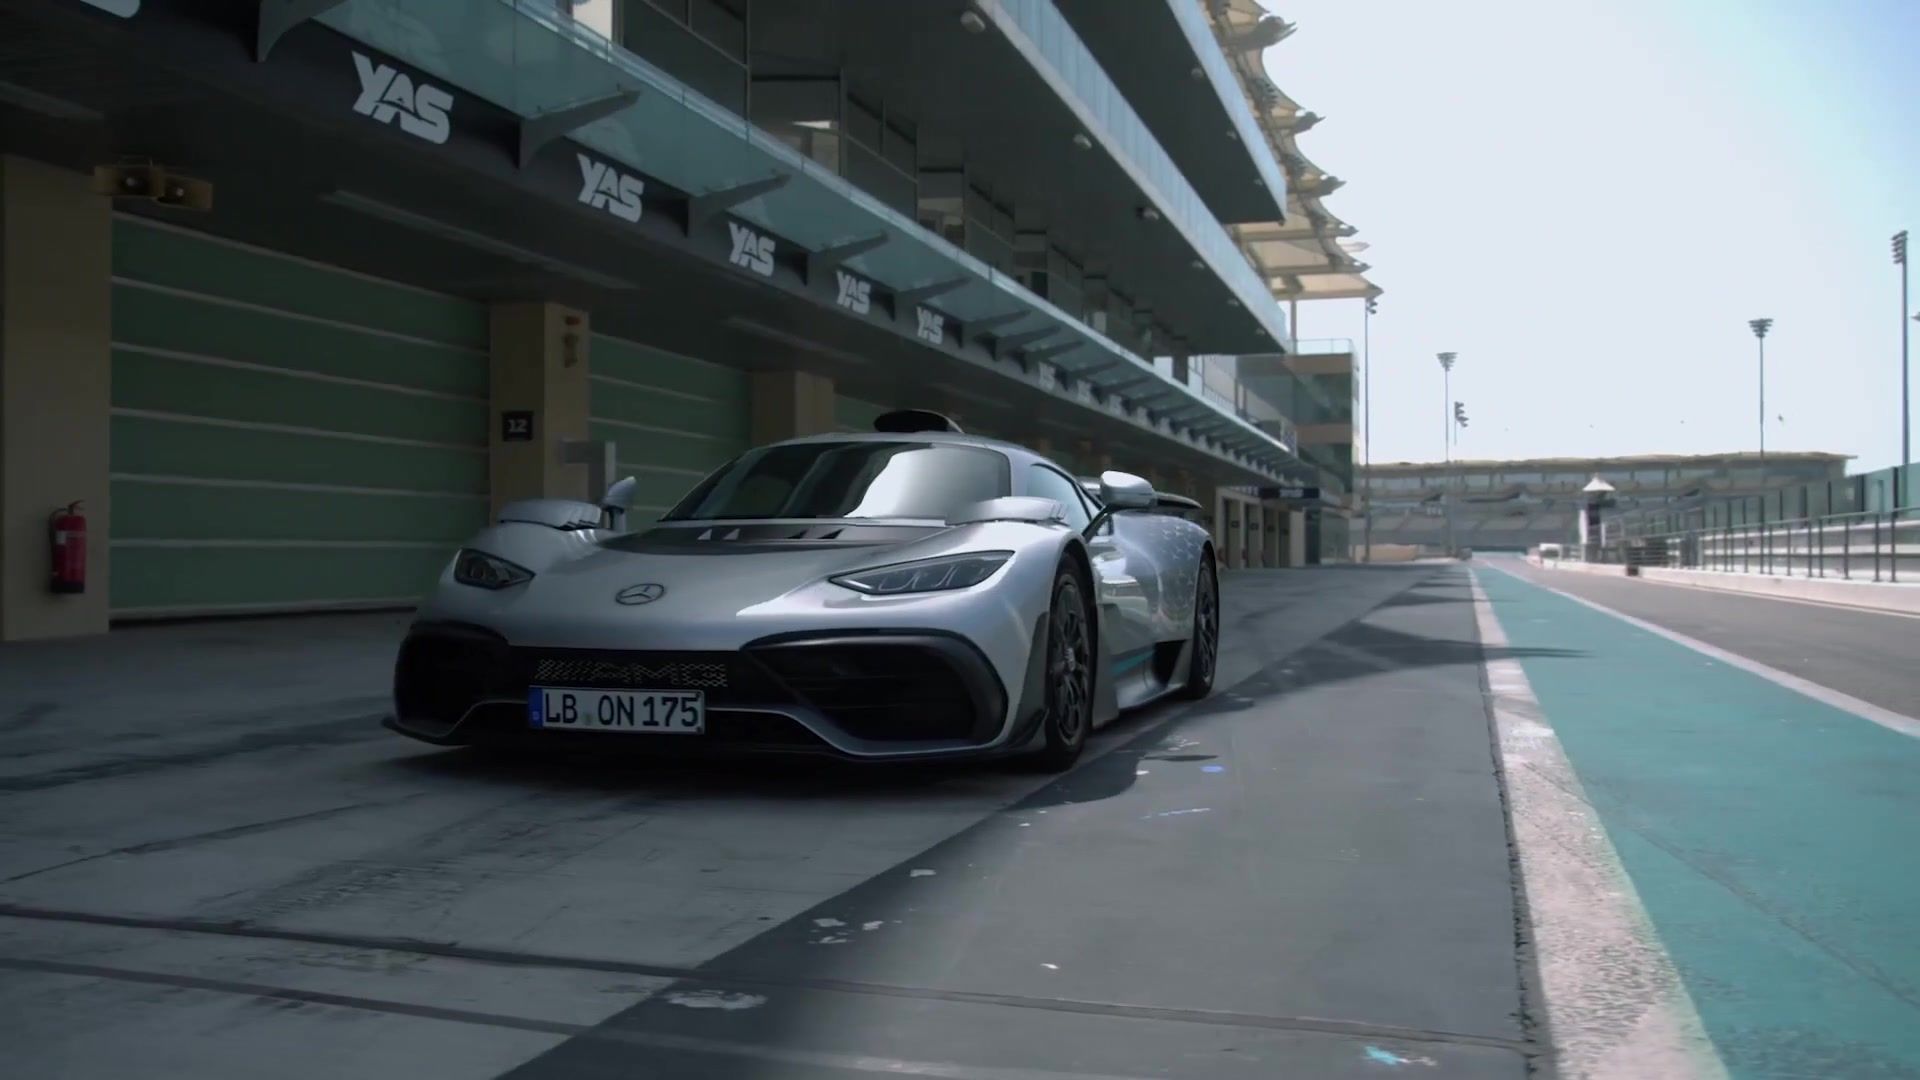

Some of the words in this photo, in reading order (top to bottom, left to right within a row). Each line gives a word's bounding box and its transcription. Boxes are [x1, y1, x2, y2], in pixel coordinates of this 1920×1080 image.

[352, 50, 454, 145] YAS
[576, 152, 645, 223] YAS
[728, 221, 775, 277] YAS
[836, 270, 871, 316] YAS
[916, 305, 943, 345] YAS
[507, 417, 528, 433] 12
[545, 693, 578, 724] LB
[642, 696, 699, 727] 175
